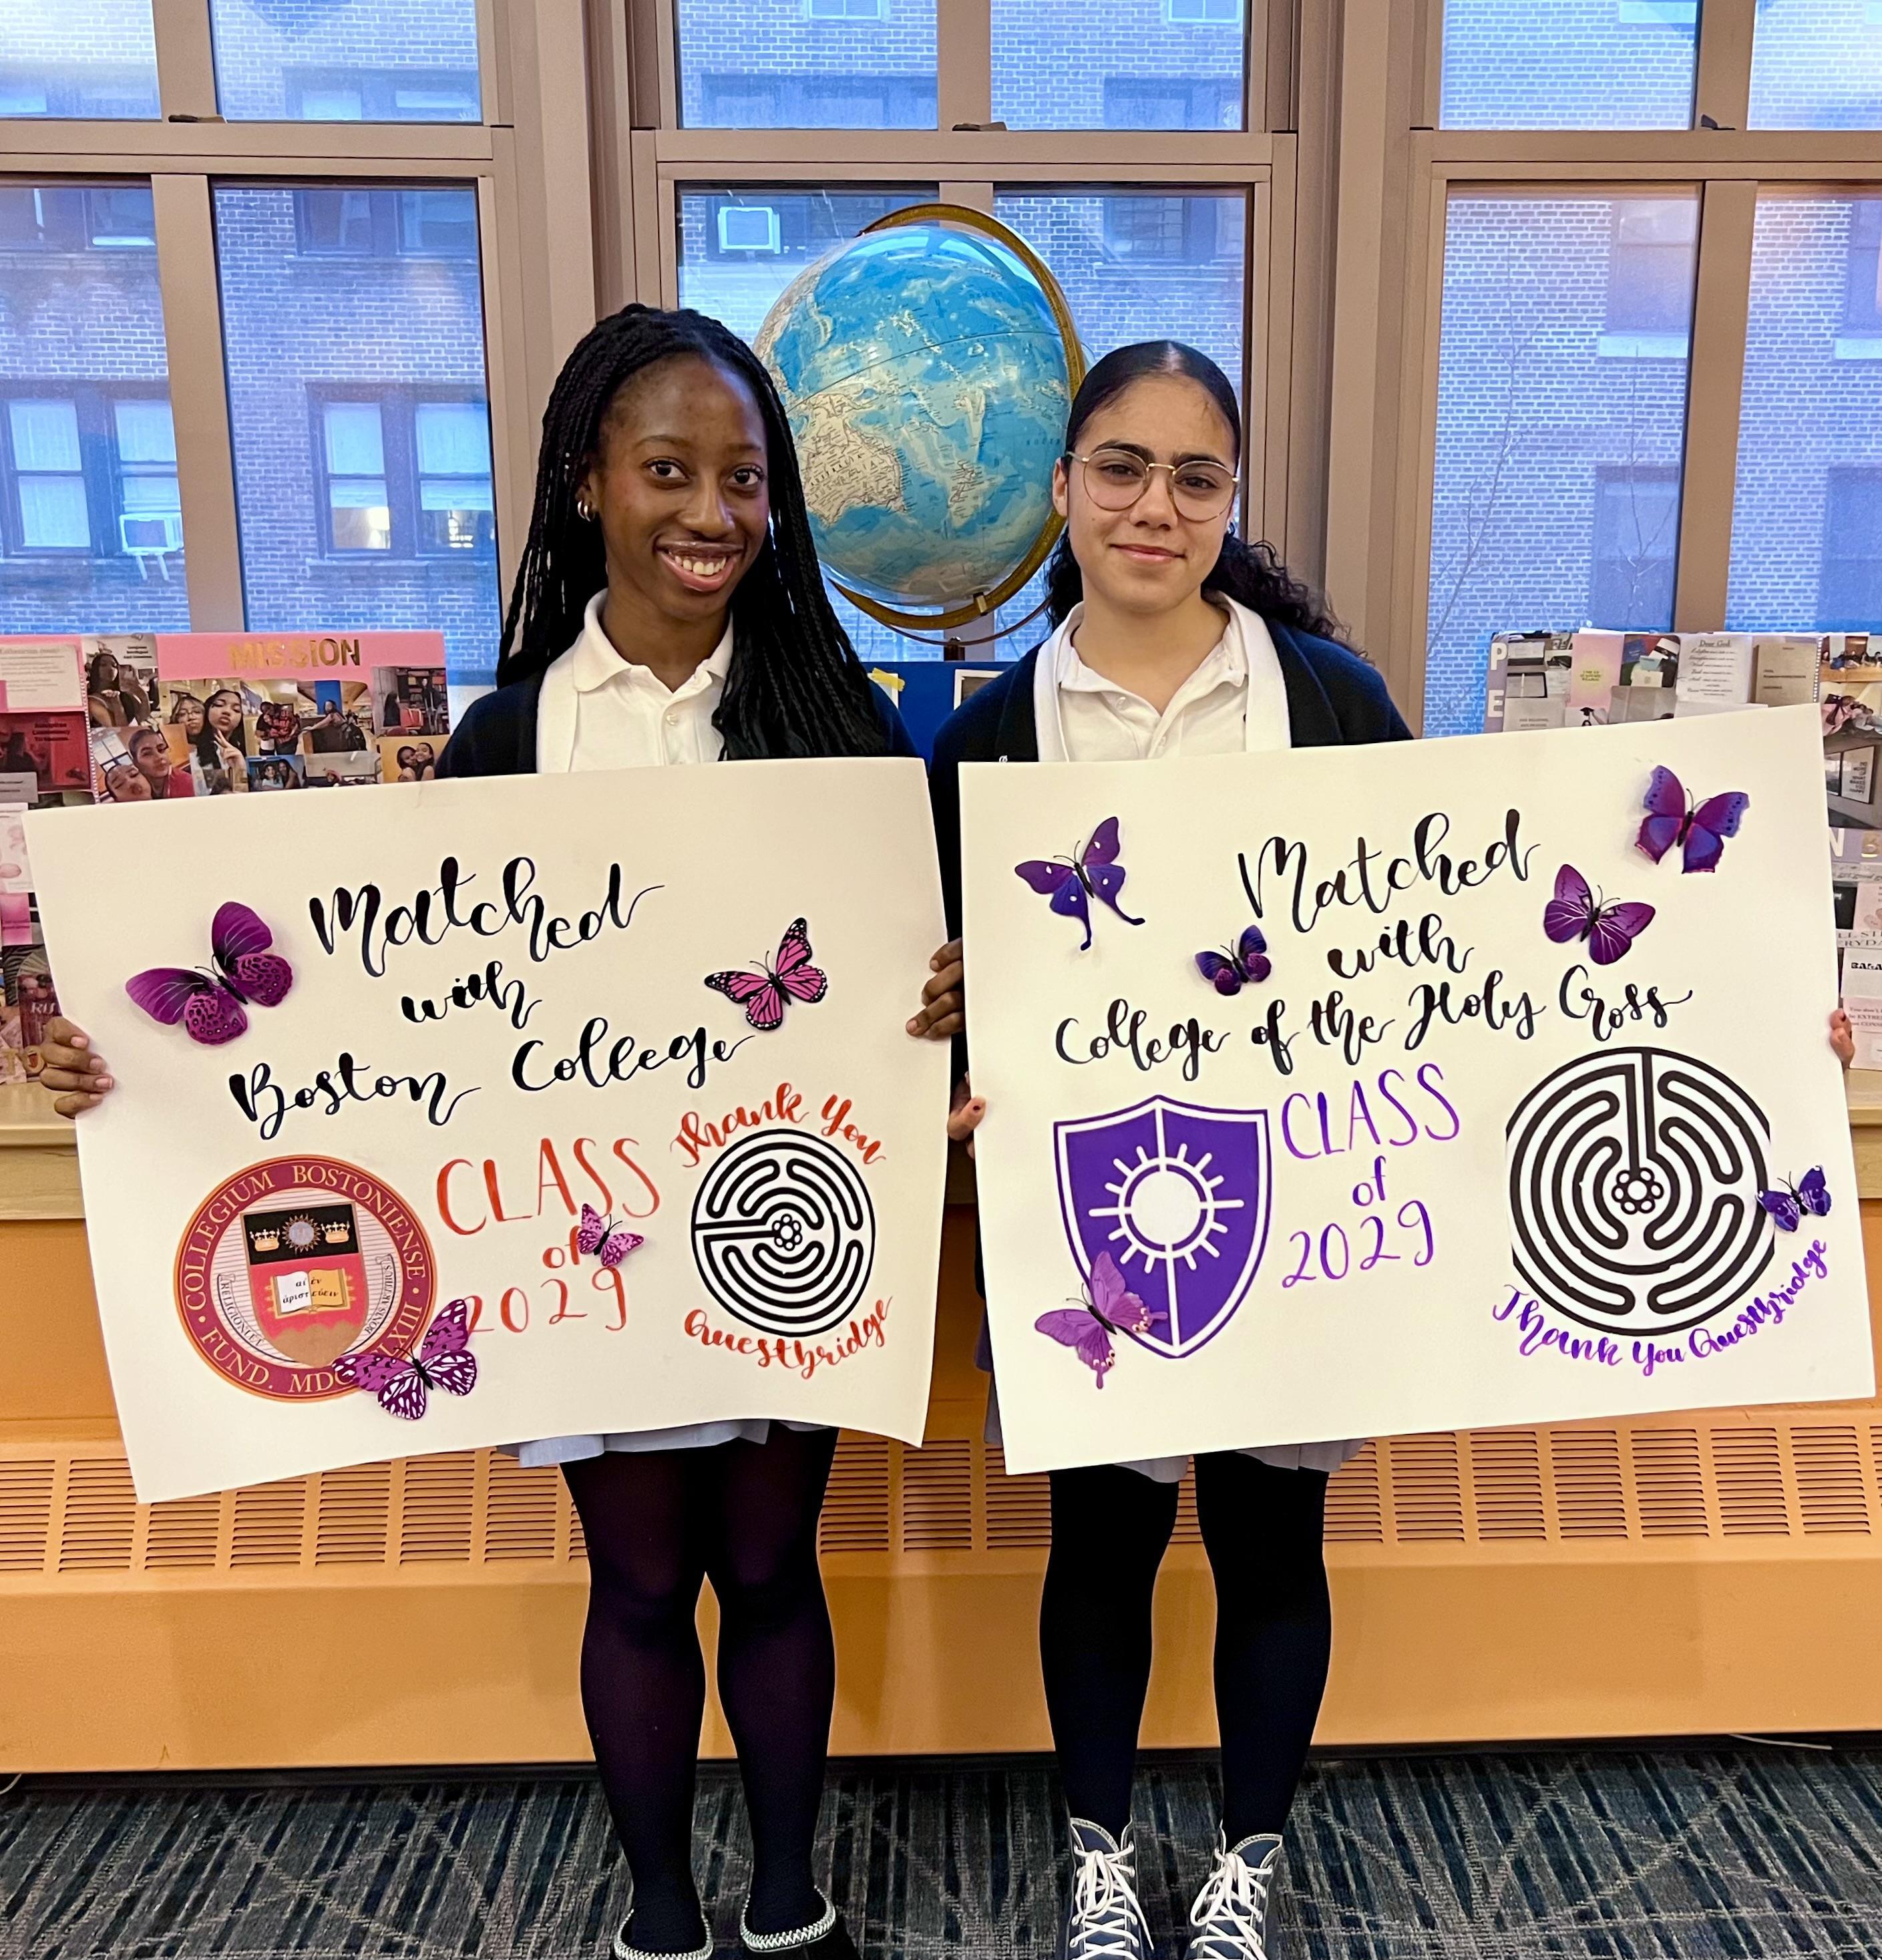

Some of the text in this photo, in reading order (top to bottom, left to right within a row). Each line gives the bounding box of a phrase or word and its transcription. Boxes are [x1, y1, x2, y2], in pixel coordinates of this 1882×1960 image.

[228, 638, 361, 670] MISSION
[310, 856, 665, 977] Matched
[1238, 809, 1541, 934] Matched
[1328, 913, 1475, 978] with
[401, 960, 542, 1029] with
[1055, 964, 1694, 1081] College of the Holy Cross
[229, 1016, 755, 1140] Boston College
[1281, 1063, 1461, 1159] CLASS
[670, 1083, 886, 1169] Thank You
[436, 1137, 661, 1235] CLASS
[1352, 1155, 1387, 1207] of
[183, 1165, 426, 1311] COLLEGIUM BOSTONIENSE
[542, 1225, 580, 1269] of
[1282, 1200, 1435, 1288] 2029
[463, 1265, 627, 1337] 2029
[684, 1296, 893, 1380] Questbridge
[1493, 1238, 1829, 1377] Thank You Questbridge
[200, 1301, 423, 1394] FUND. MDCLXIII
